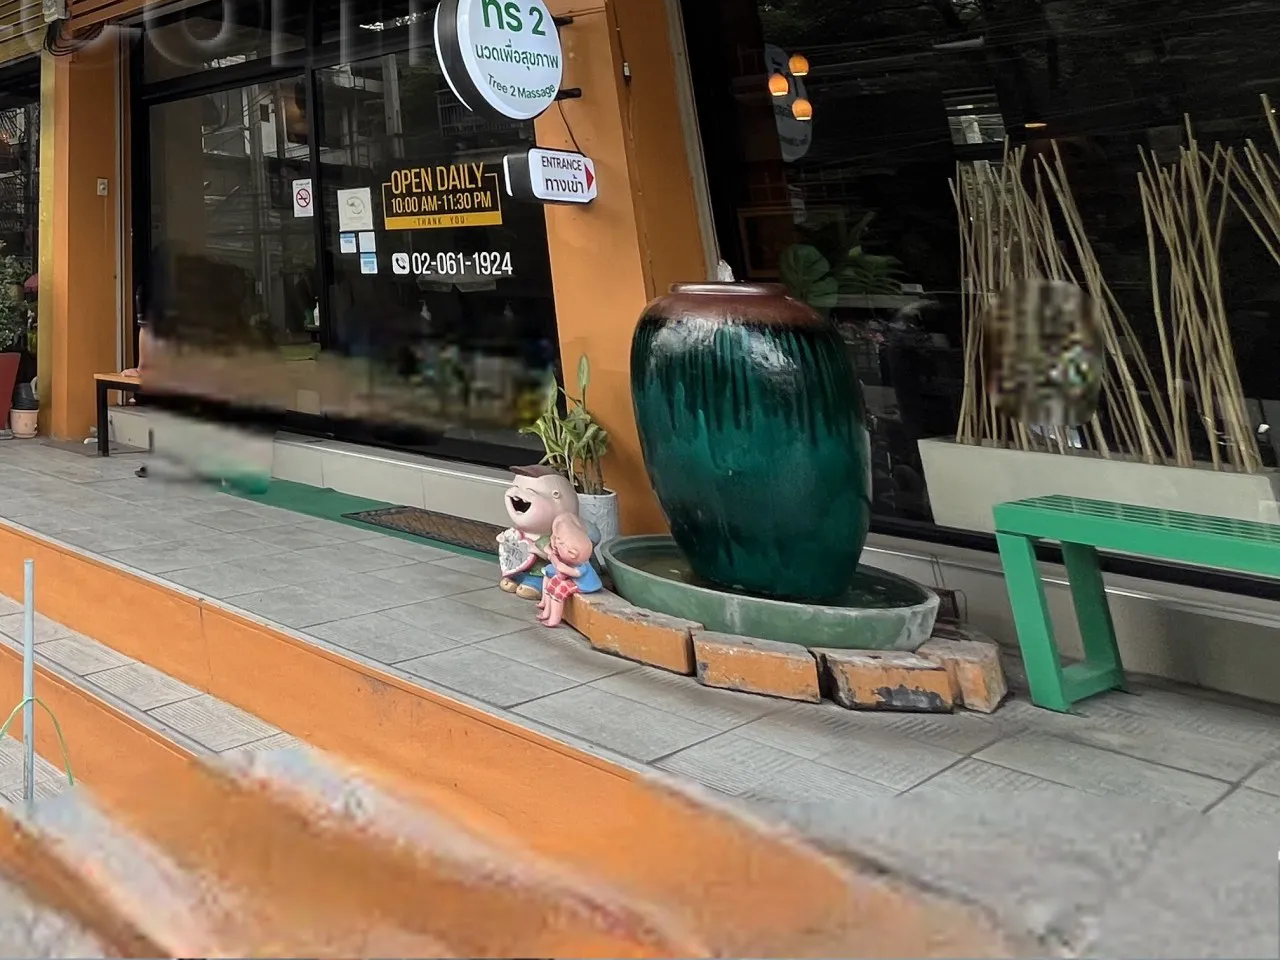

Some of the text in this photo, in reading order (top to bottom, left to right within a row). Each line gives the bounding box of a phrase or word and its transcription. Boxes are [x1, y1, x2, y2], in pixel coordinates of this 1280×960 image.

[528, 6, 546, 36] 2
[475, 38, 559, 71] นวดเพื่อสุขภาพ
[488, 73, 556, 99] Tree 2 Massage
[541, 156, 582, 171] ENTRANCE
[391, 161, 484, 194] OPEN DAILY
[545, 174, 584, 193] ทางเข้า
[391, 196, 419, 213] 10:00
[474, 191, 492, 208] PM
[412, 252, 513, 275] 02-061-1924
